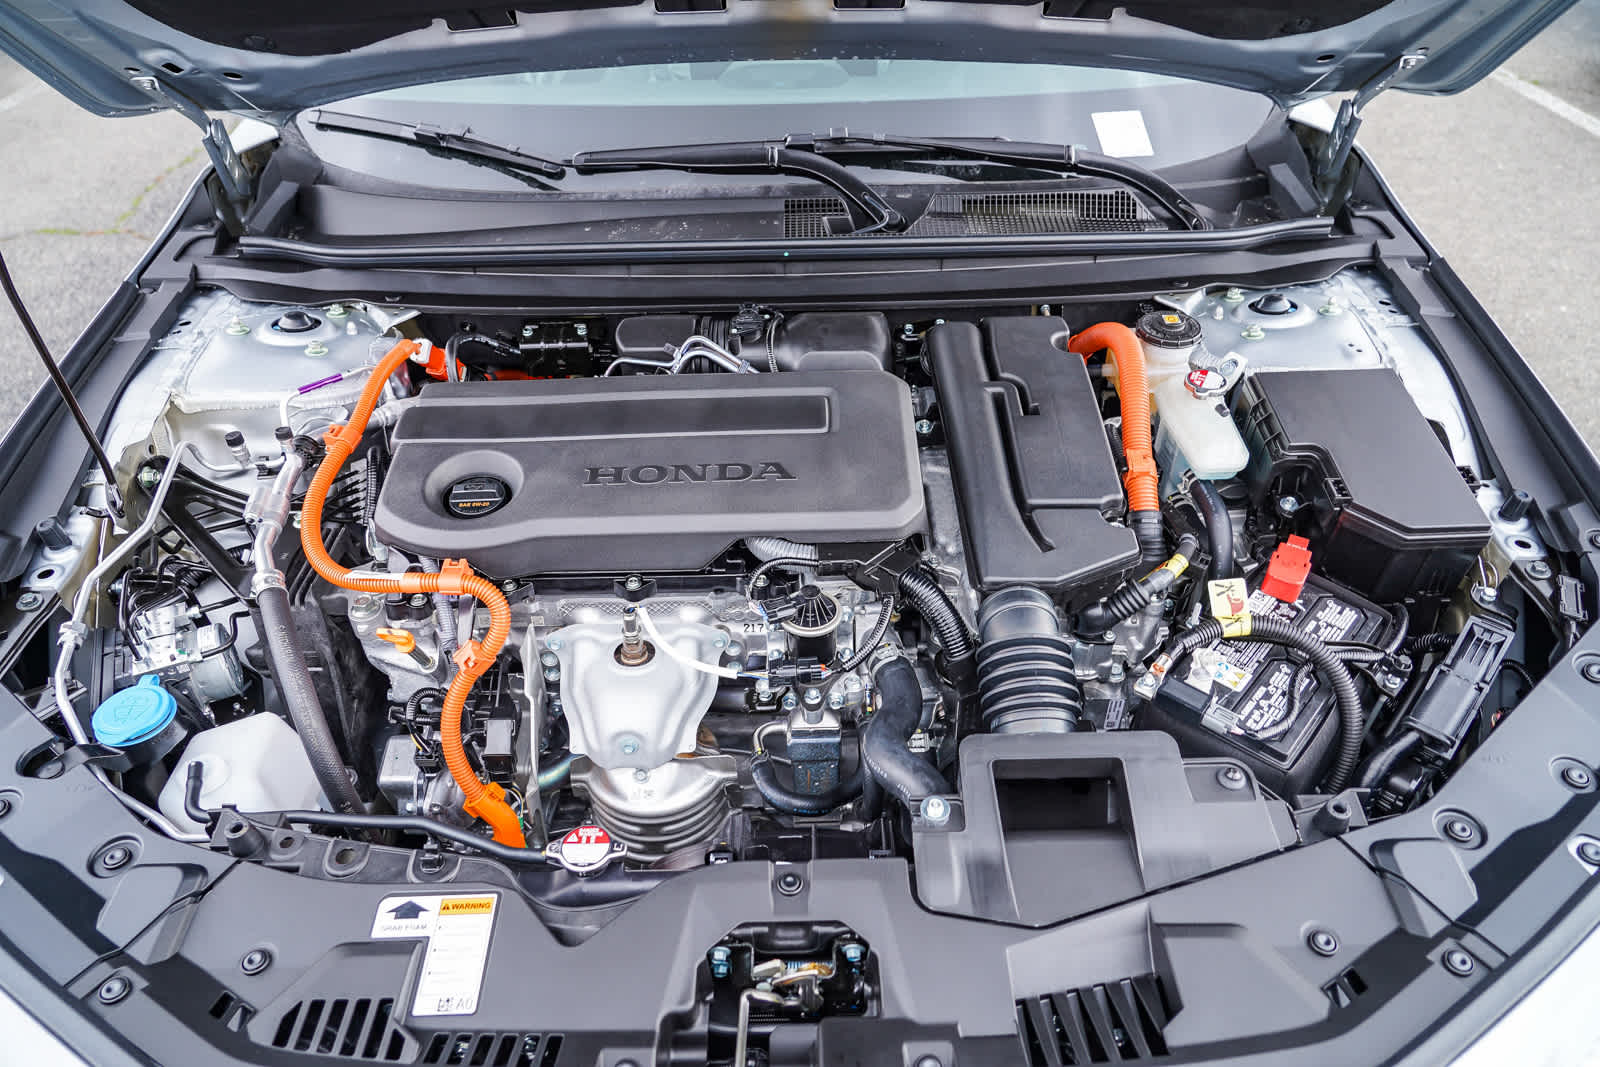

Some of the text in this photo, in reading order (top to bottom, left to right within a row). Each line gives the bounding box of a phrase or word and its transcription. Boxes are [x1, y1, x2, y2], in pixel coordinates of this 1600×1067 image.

[582, 462, 799, 486] HONDA
[743, 623, 765, 633] 217
[451, 902, 491, 910] WARNING
